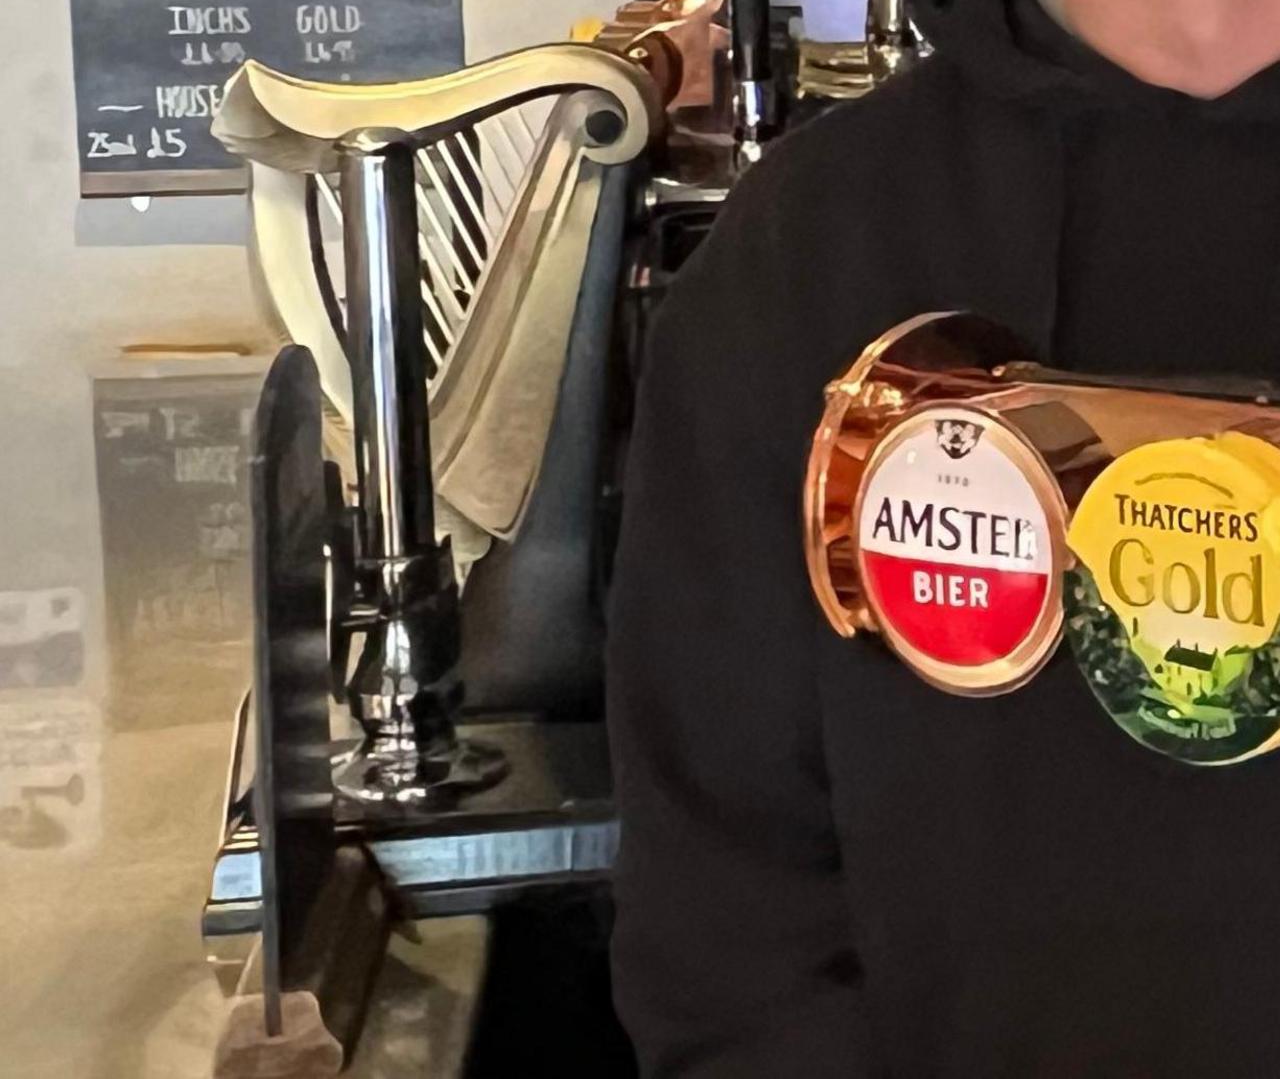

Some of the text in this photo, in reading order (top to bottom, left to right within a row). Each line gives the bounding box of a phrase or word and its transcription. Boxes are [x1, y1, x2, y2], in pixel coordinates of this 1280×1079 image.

[167, 4, 362, 35] INCHS GOLD
[873, 497, 1035, 561] AMSTEL
[1114, 493, 1259, 542] THATCHERS
[912, 570, 990, 609] BIER
[1109, 538, 1266, 627] Gold
